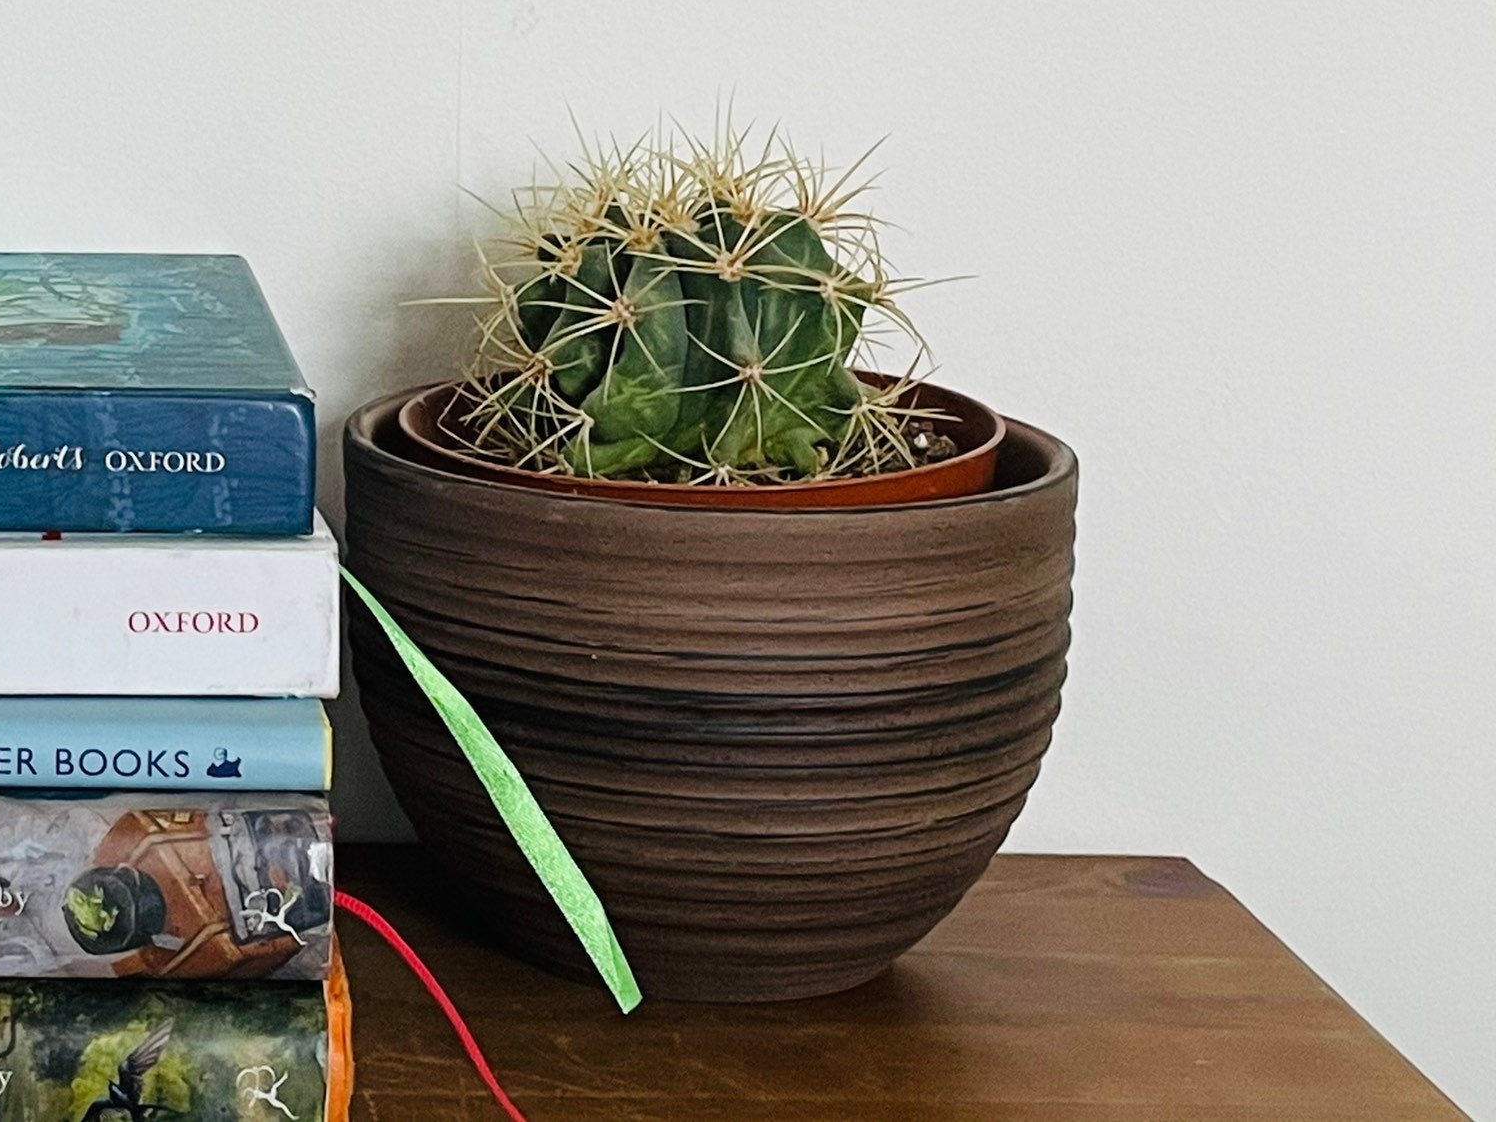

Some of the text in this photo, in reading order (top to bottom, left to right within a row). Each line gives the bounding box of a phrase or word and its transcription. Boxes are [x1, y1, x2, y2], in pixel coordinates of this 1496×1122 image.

[104, 449, 227, 473] OXFORD
[127, 610, 260, 635] OXFORD
[53, 747, 191, 779] BOOKS
